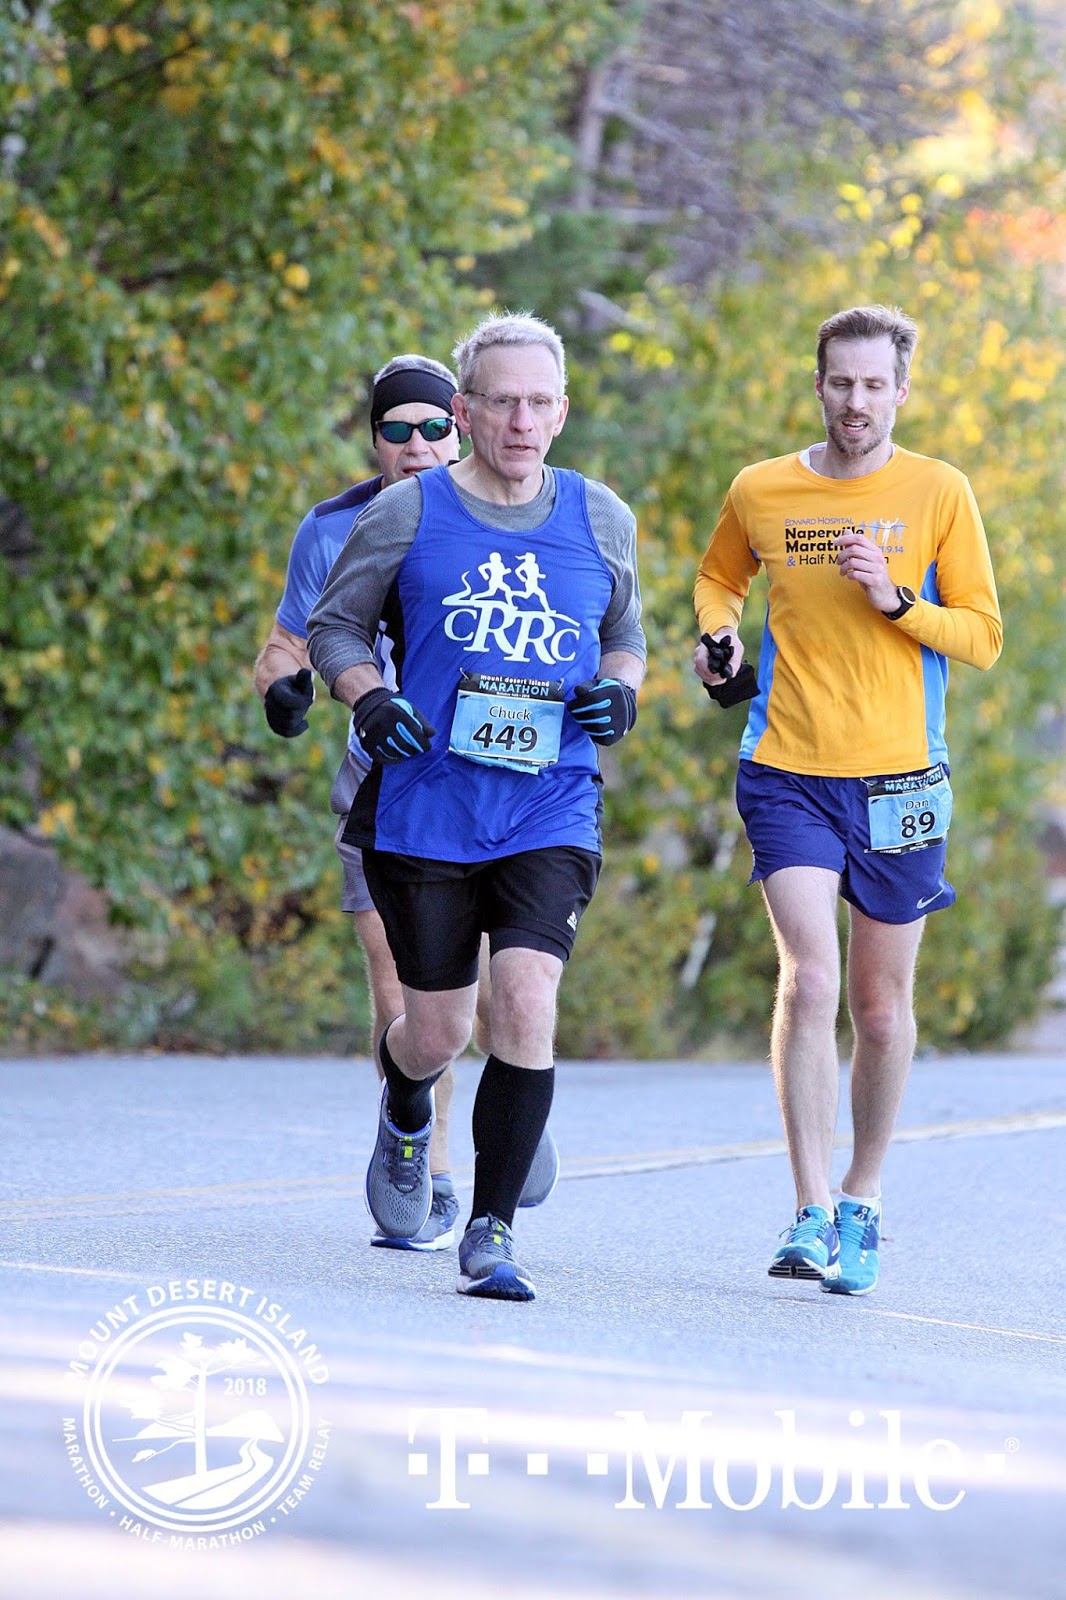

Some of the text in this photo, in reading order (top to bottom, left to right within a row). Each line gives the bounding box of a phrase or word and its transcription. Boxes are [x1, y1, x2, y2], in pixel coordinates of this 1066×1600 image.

[785, 526, 864, 540] Napervile
[785, 540, 844, 553] Marath
[787, 555, 796, 567] &
[799, 553, 825, 565] Half
[479, 680, 550, 697] MARATHON
[489, 705, 531, 721] Chuck
[472, 722, 538, 752] 449
[885, 771, 942, 792] MARATHON
[905, 799, 929, 810] Dan
[901, 811, 936, 839] 89
